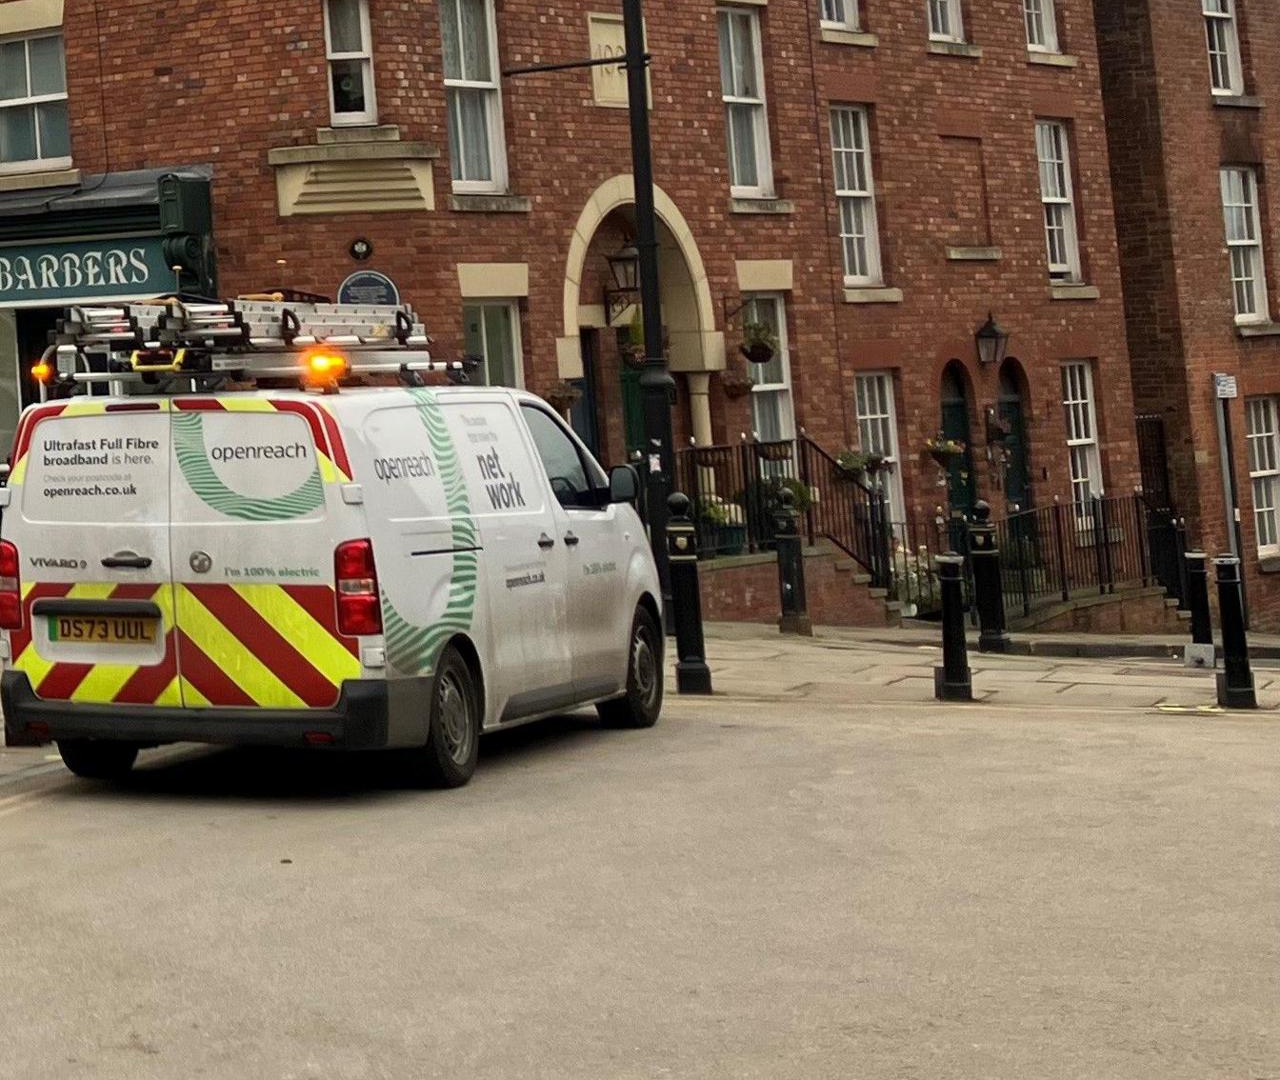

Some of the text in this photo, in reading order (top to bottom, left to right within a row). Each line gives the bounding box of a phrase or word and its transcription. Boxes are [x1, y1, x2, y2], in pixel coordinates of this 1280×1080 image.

[43, 437, 159, 453] Ultrafast Full Fibre
[211, 441, 307, 463] openreach
[43, 452, 154, 466] broadband is here.
[373, 449, 435, 486] openreach
[476, 446, 506, 482] net
[43, 484, 137, 498] openreach.co.uk
[485, 471, 526, 511] work
[29, 556, 78, 569] VIVARO
[244, 566, 276, 577] 100%
[278, 567, 321, 577] electric
[60, 618, 153, 641] DS73 UUL
